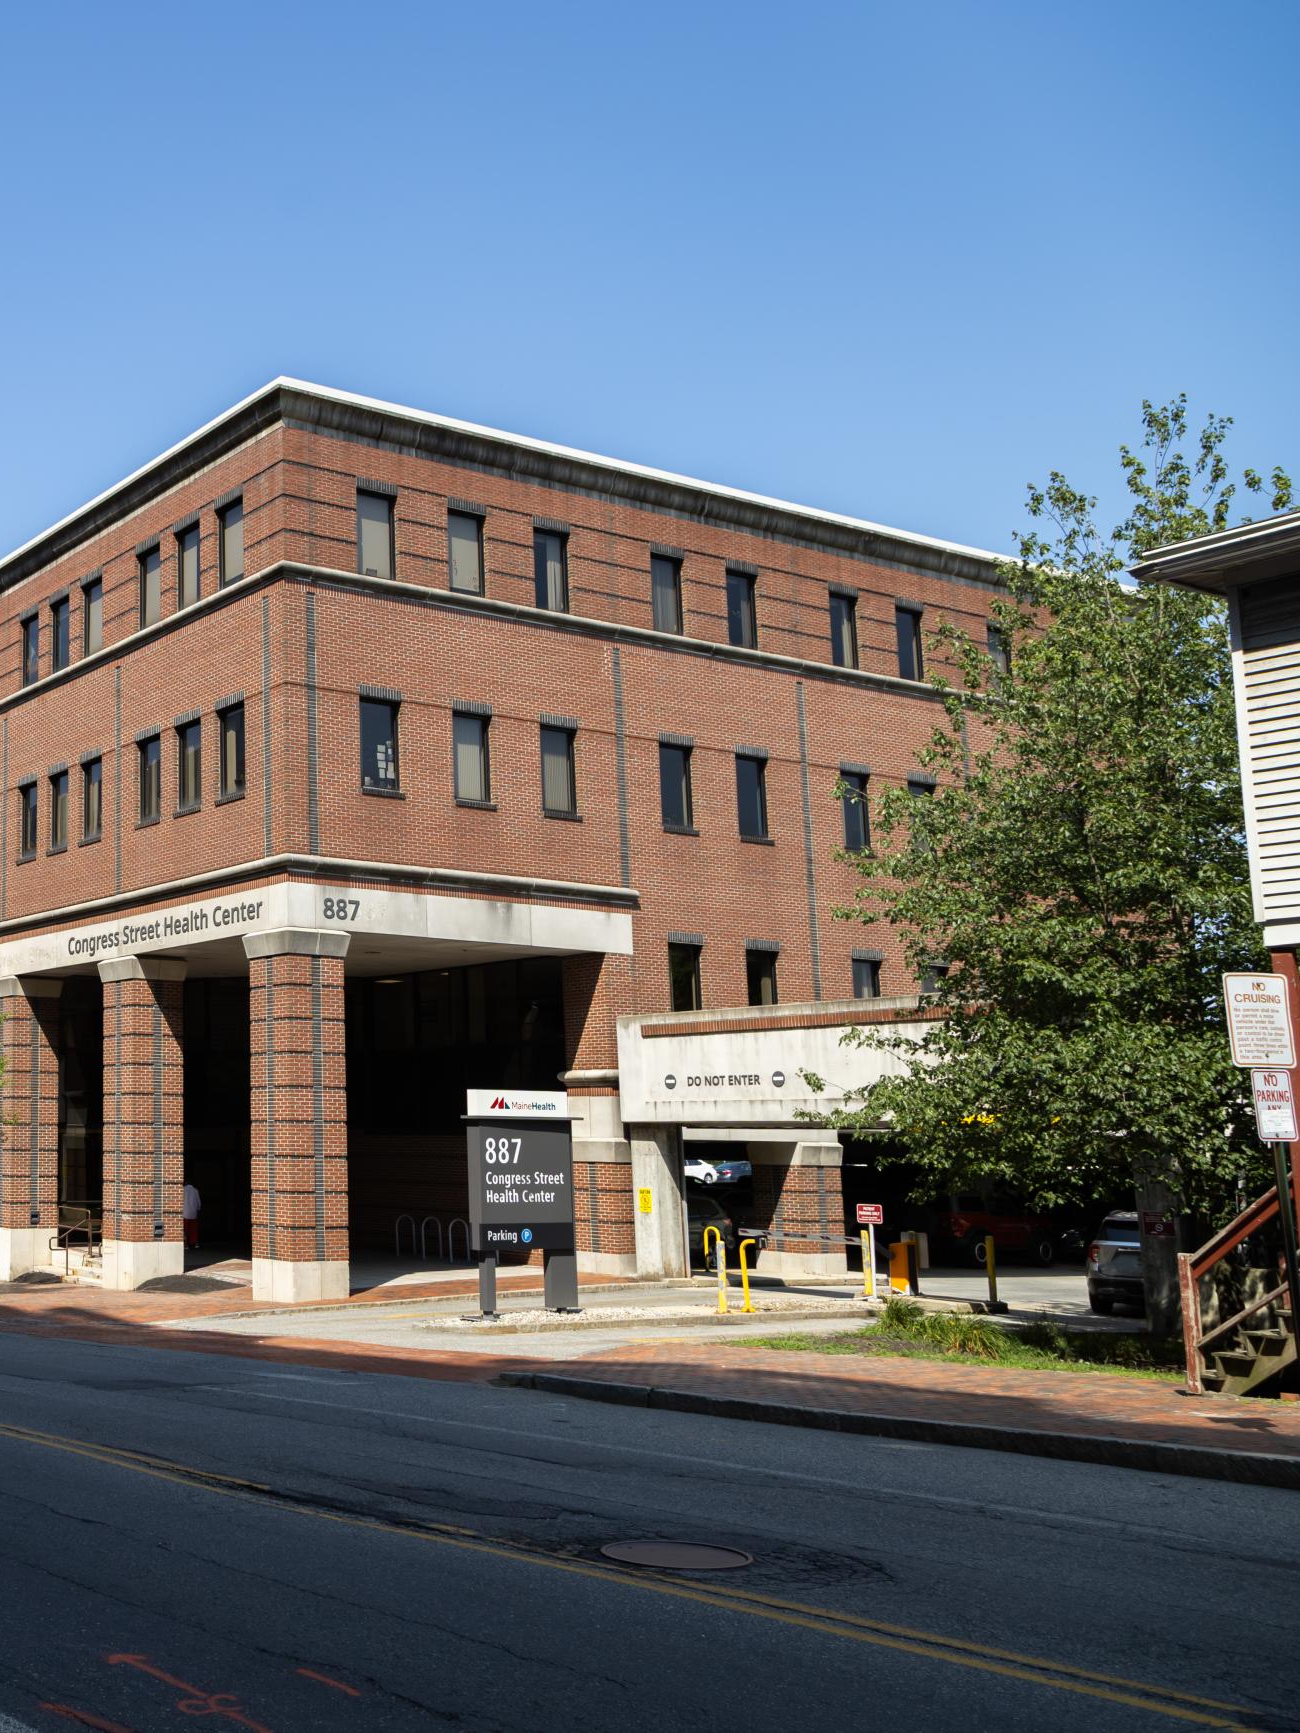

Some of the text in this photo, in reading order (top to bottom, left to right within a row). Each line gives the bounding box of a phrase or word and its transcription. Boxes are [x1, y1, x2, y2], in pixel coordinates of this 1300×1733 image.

[323, 897, 360, 921] 887
[68, 901, 263, 958] Congress Street Health Center
[1251, 982, 1266, 991] NO
[1234, 993, 1281, 1004] CRUISING
[687, 1074, 761, 1087] DO NOT ENTER
[1263, 1074, 1278, 1087] NO
[1256, 1090, 1290, 1103] PARKING
[511, 1101, 556, 1111] MaineHealth
[485, 1137, 522, 1164] 887
[485, 1171, 565, 1188] Congress Street
[486, 1188, 555, 1203] Health Center
[487, 1230, 518, 1243] Parking
